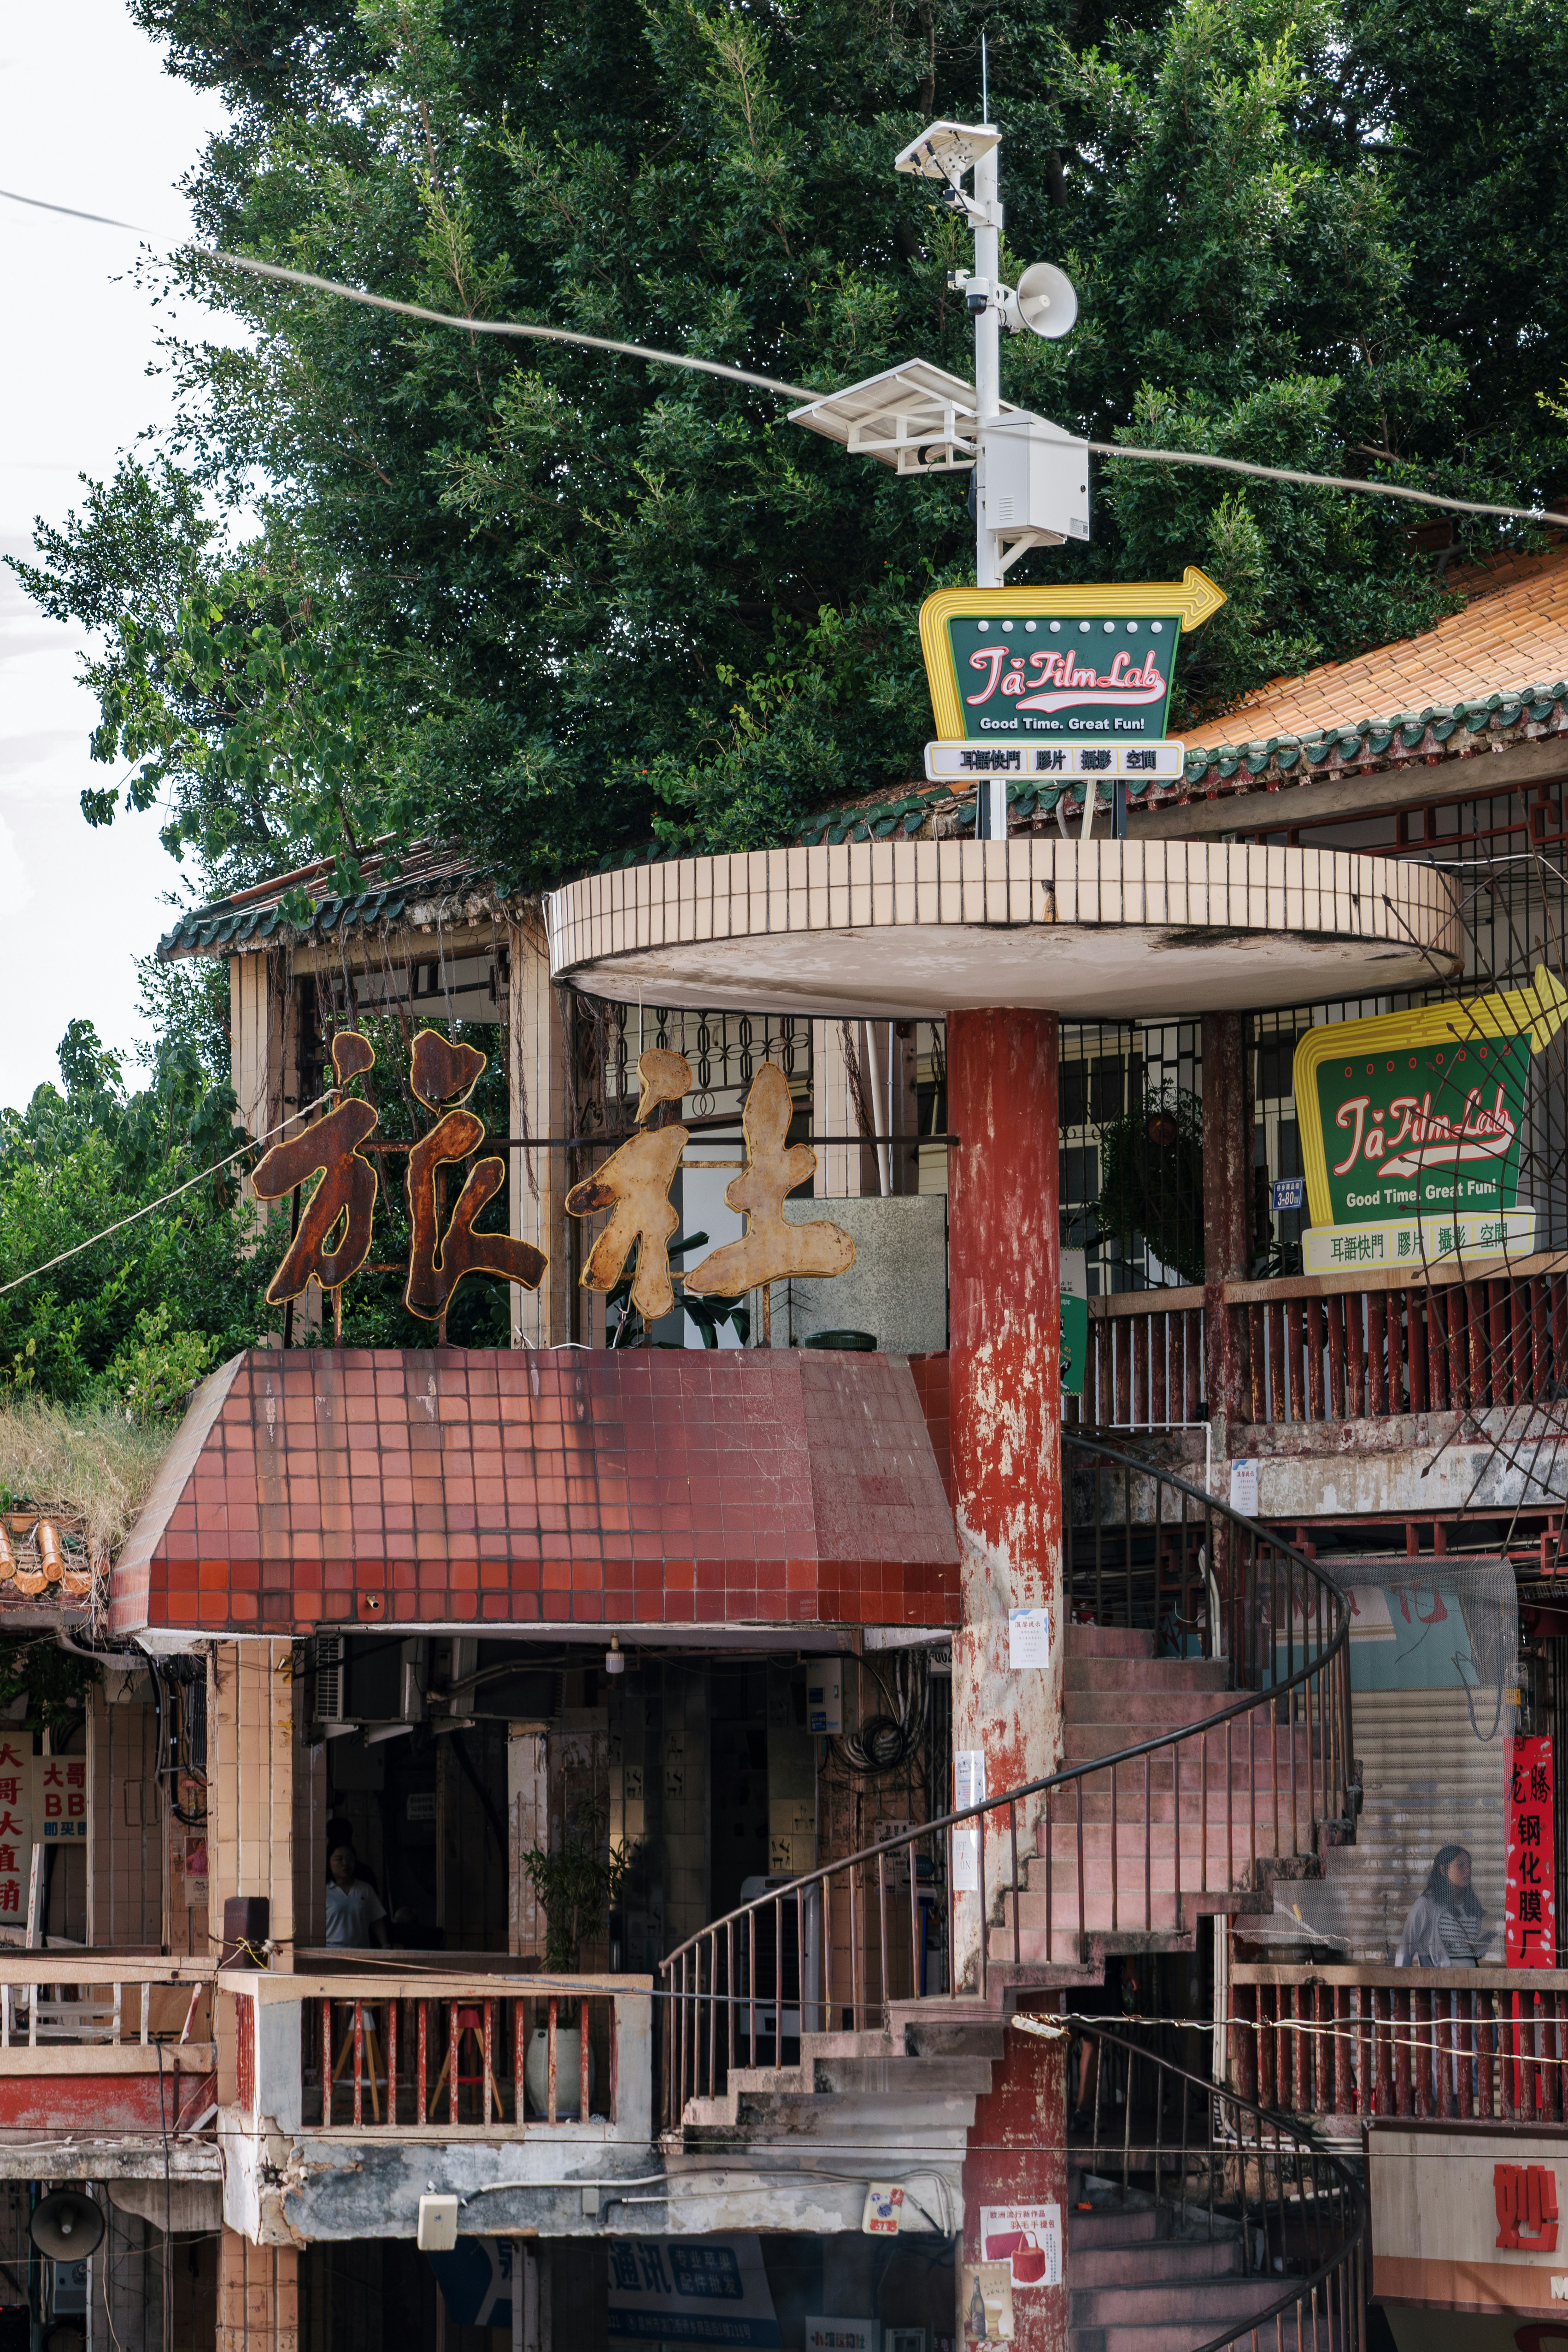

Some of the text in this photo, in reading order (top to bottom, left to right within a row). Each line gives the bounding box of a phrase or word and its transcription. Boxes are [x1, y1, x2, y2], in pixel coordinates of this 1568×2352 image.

[1026, 650, 1097, 688] Film
[1097, 650, 1158, 688] Lab
[980, 718, 1145, 730] Good Time. Great Fun!
[961, 750, 1157, 770] 耳語快門 膠片 攝影 空間
[1387, 1092, 1450, 1147] Film
[1451, 1083, 1512, 1138] Lab
[1278, 1191, 1294, 1206] 3-80
[1346, 1178, 1496, 1207] Good Time. Great Fun!
[1330, 1222, 1508, 1262] 耳語快門 膠片 攝影 空間
[43, 1762, 86, 1788] 大哥
[955, 1841, 966, 1851] OFF
[960, 1860, 971, 1870] ON
[990, 2210, 1045, 2219] 欧洲流行新作品
[1010, 2219, 1055, 2229] 羽毛手提包
[675, 2249, 732, 2270] 专业苹果
[679, 2271, 738, 2294] 配件批发
